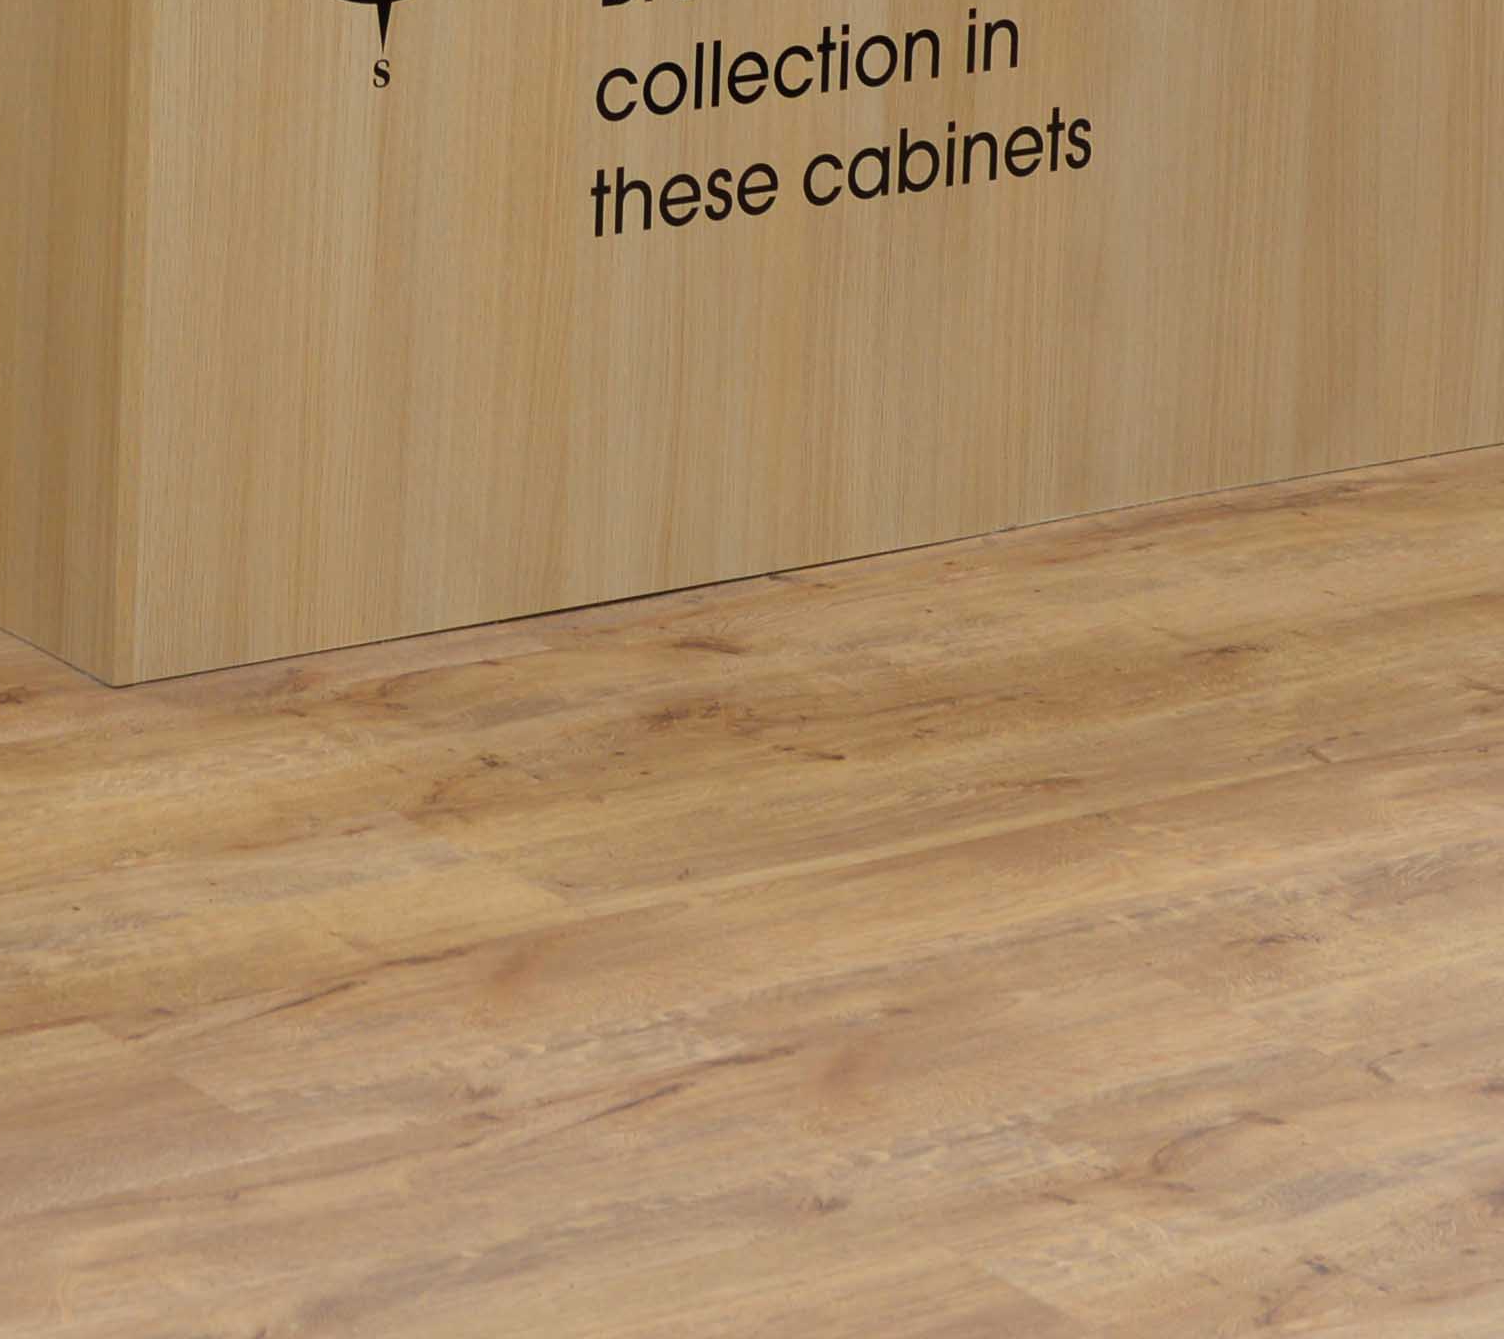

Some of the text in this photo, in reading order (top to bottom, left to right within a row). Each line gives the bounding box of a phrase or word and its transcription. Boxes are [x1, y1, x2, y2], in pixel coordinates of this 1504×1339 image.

[372, 59, 391, 88] S
[595, 7, 1019, 122] collection in
[590, 106, 1092, 238] these cabinets
